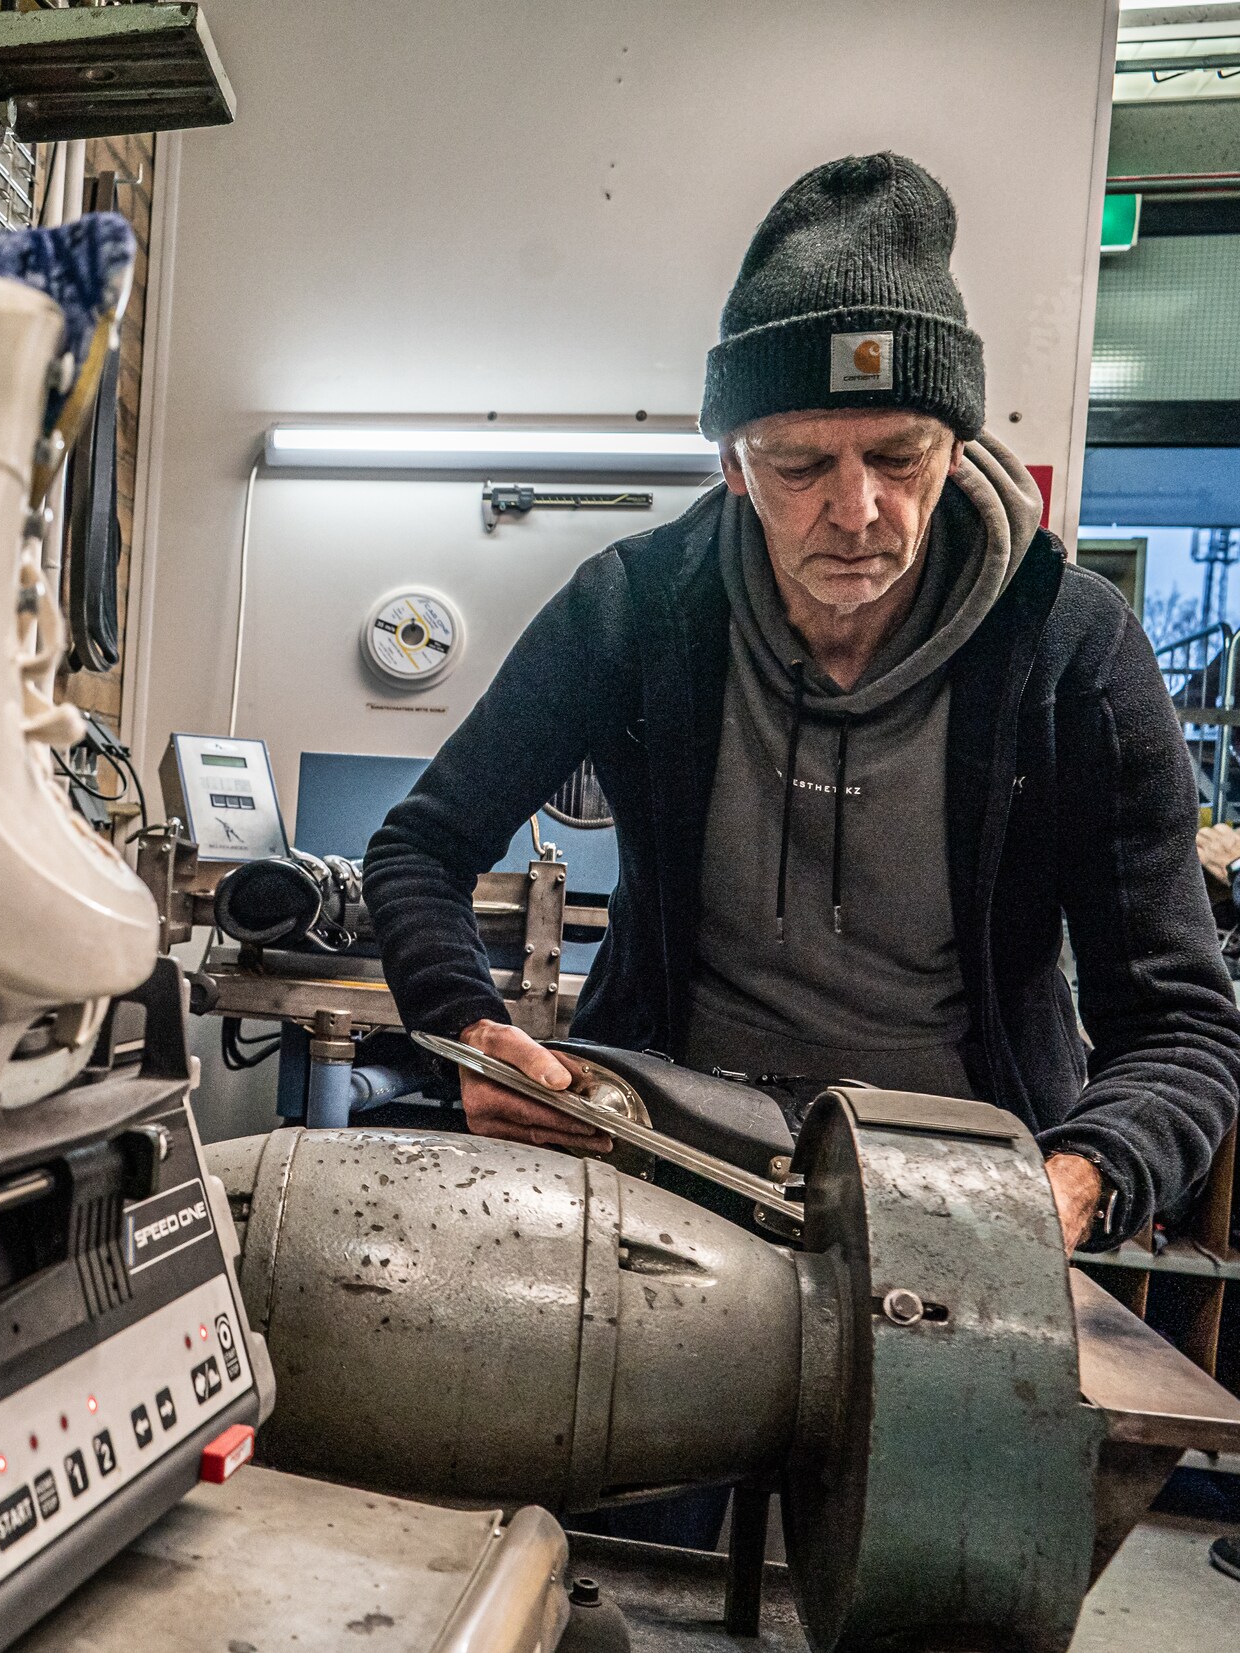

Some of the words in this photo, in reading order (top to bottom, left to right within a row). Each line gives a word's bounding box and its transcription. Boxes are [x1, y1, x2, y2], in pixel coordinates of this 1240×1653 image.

[785, 775, 861, 795] ESTHETKZ
[134, 1214, 180, 1249] SPEED
[178, 1201, 207, 1227] ONE
